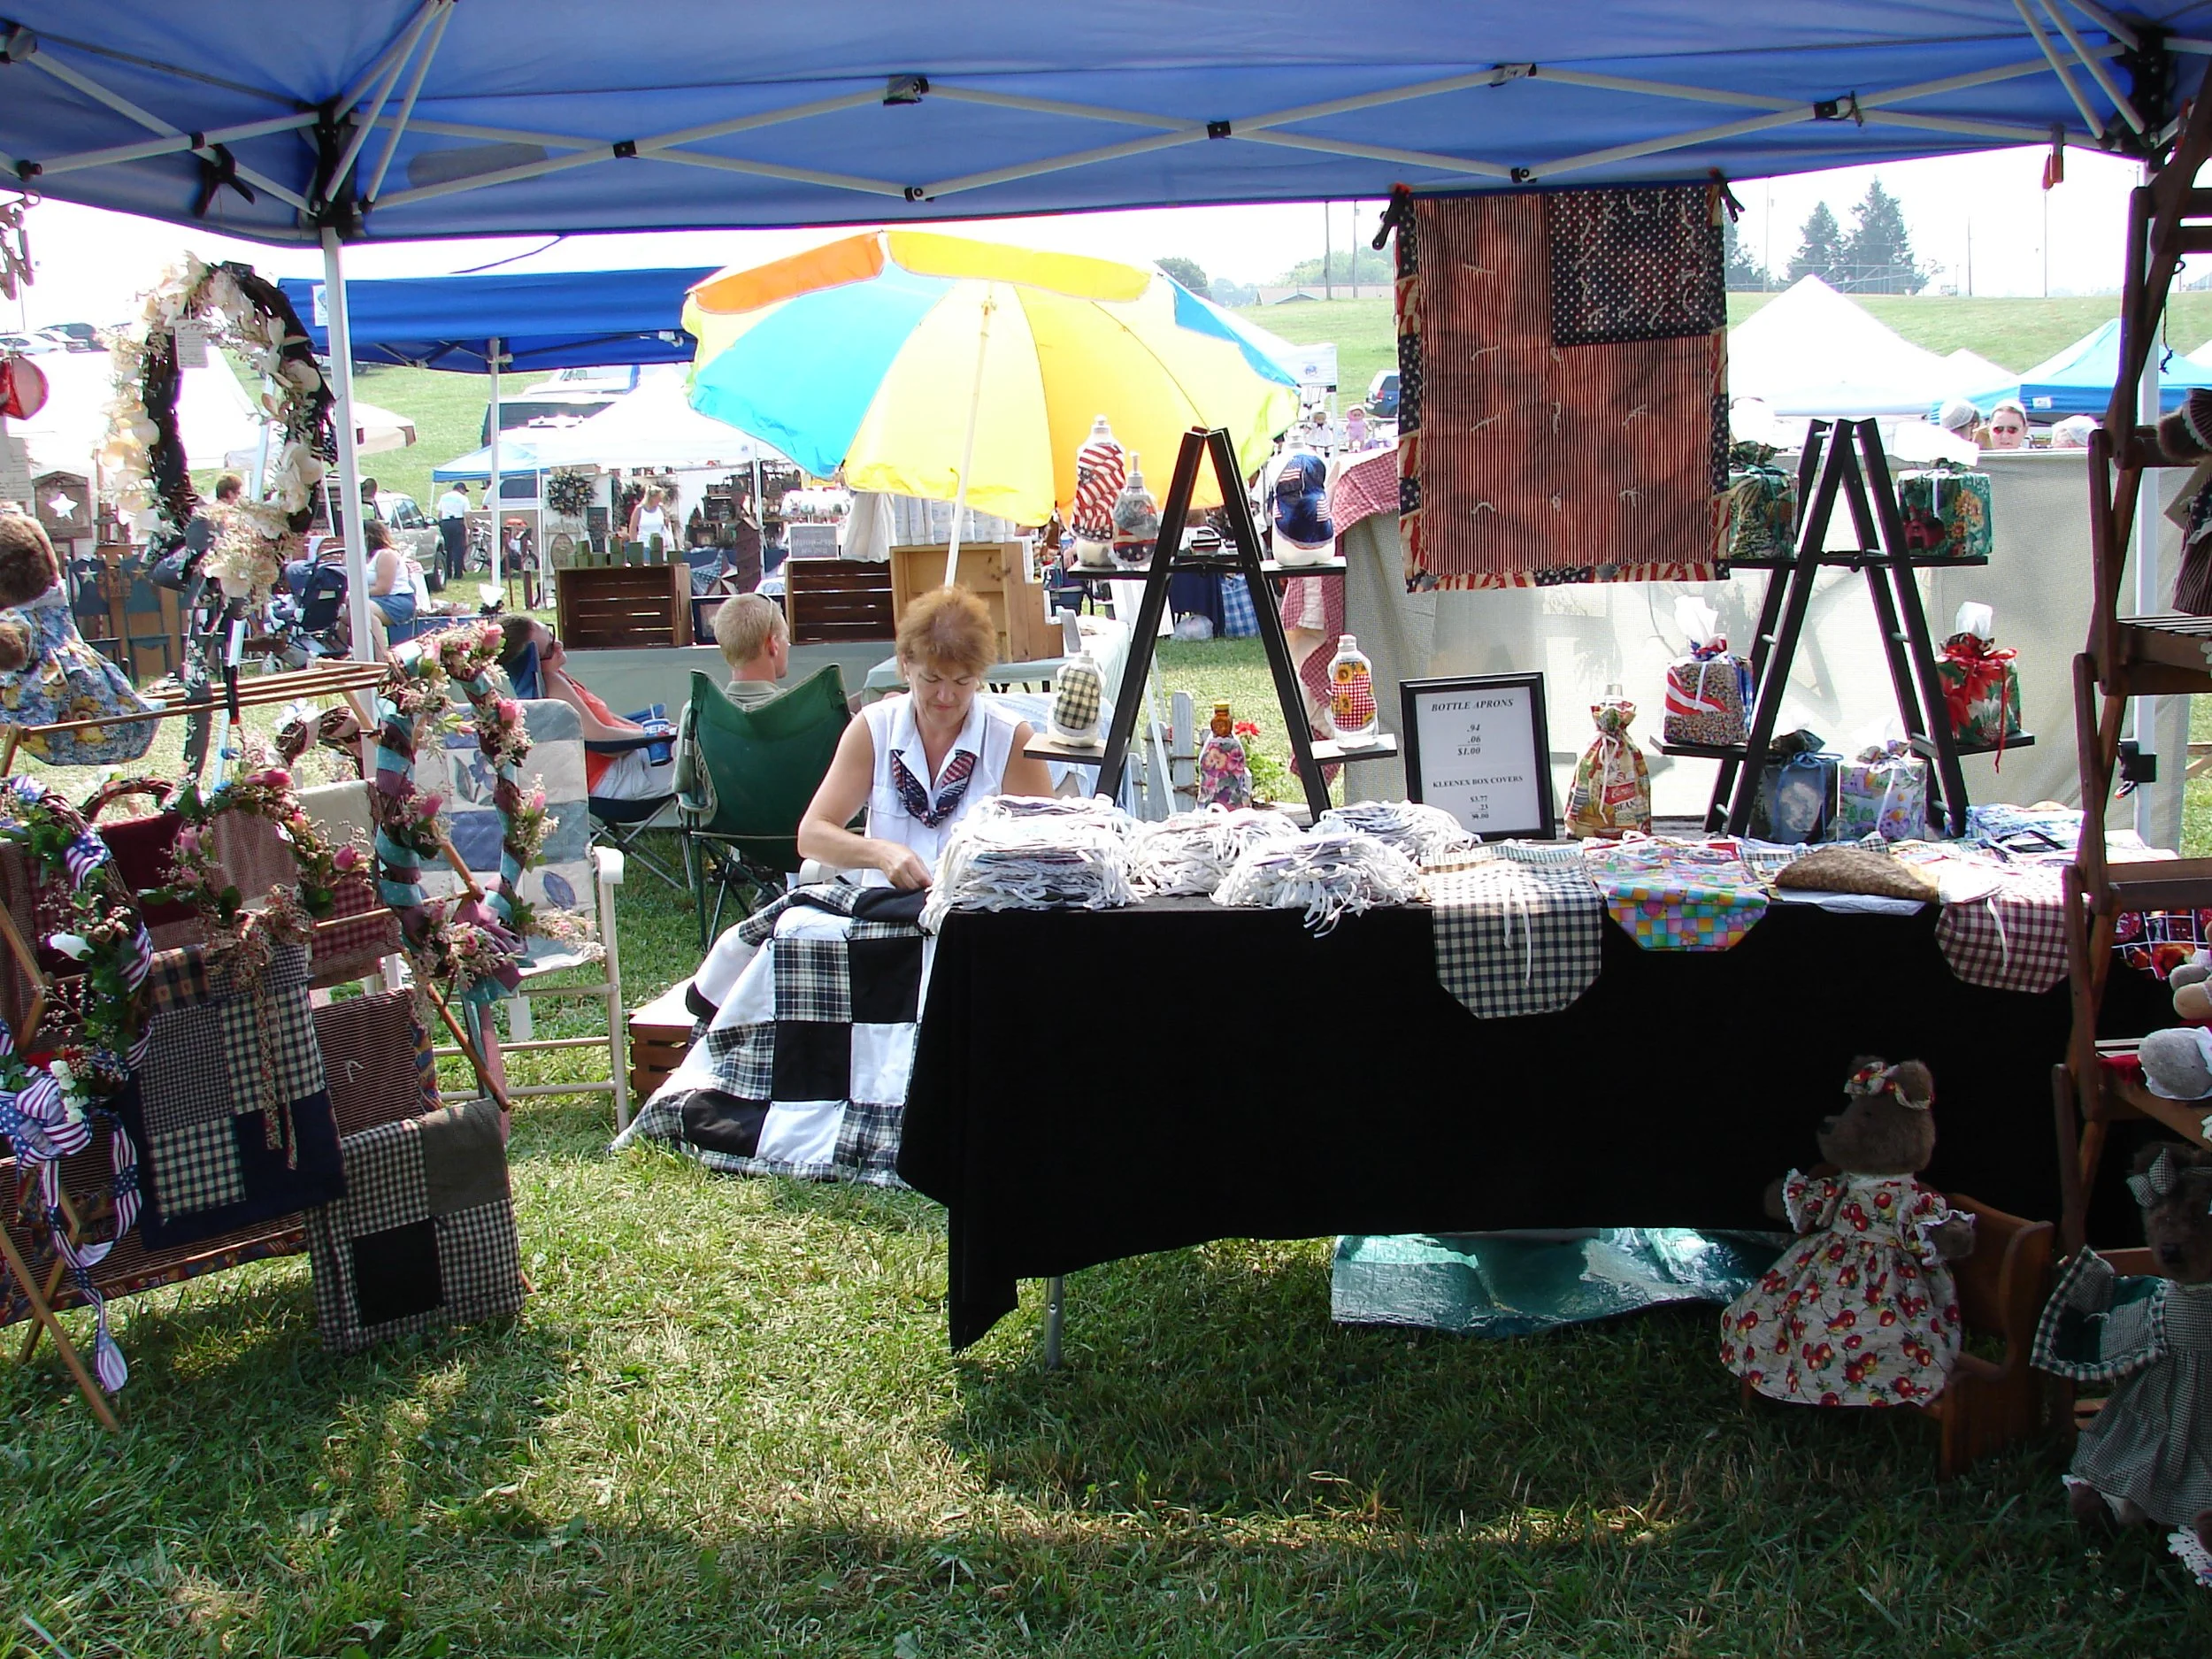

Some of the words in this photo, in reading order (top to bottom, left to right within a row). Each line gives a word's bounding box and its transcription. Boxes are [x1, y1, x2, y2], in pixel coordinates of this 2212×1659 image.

[1432, 702, 1471, 712] BOTTLE
[1473, 698, 1514, 709] APRONS
[1457, 747, 1481, 757] $1.00
[1432, 780, 1471, 788] KLEENEX
[1490, 776, 1523, 785] COVERS
